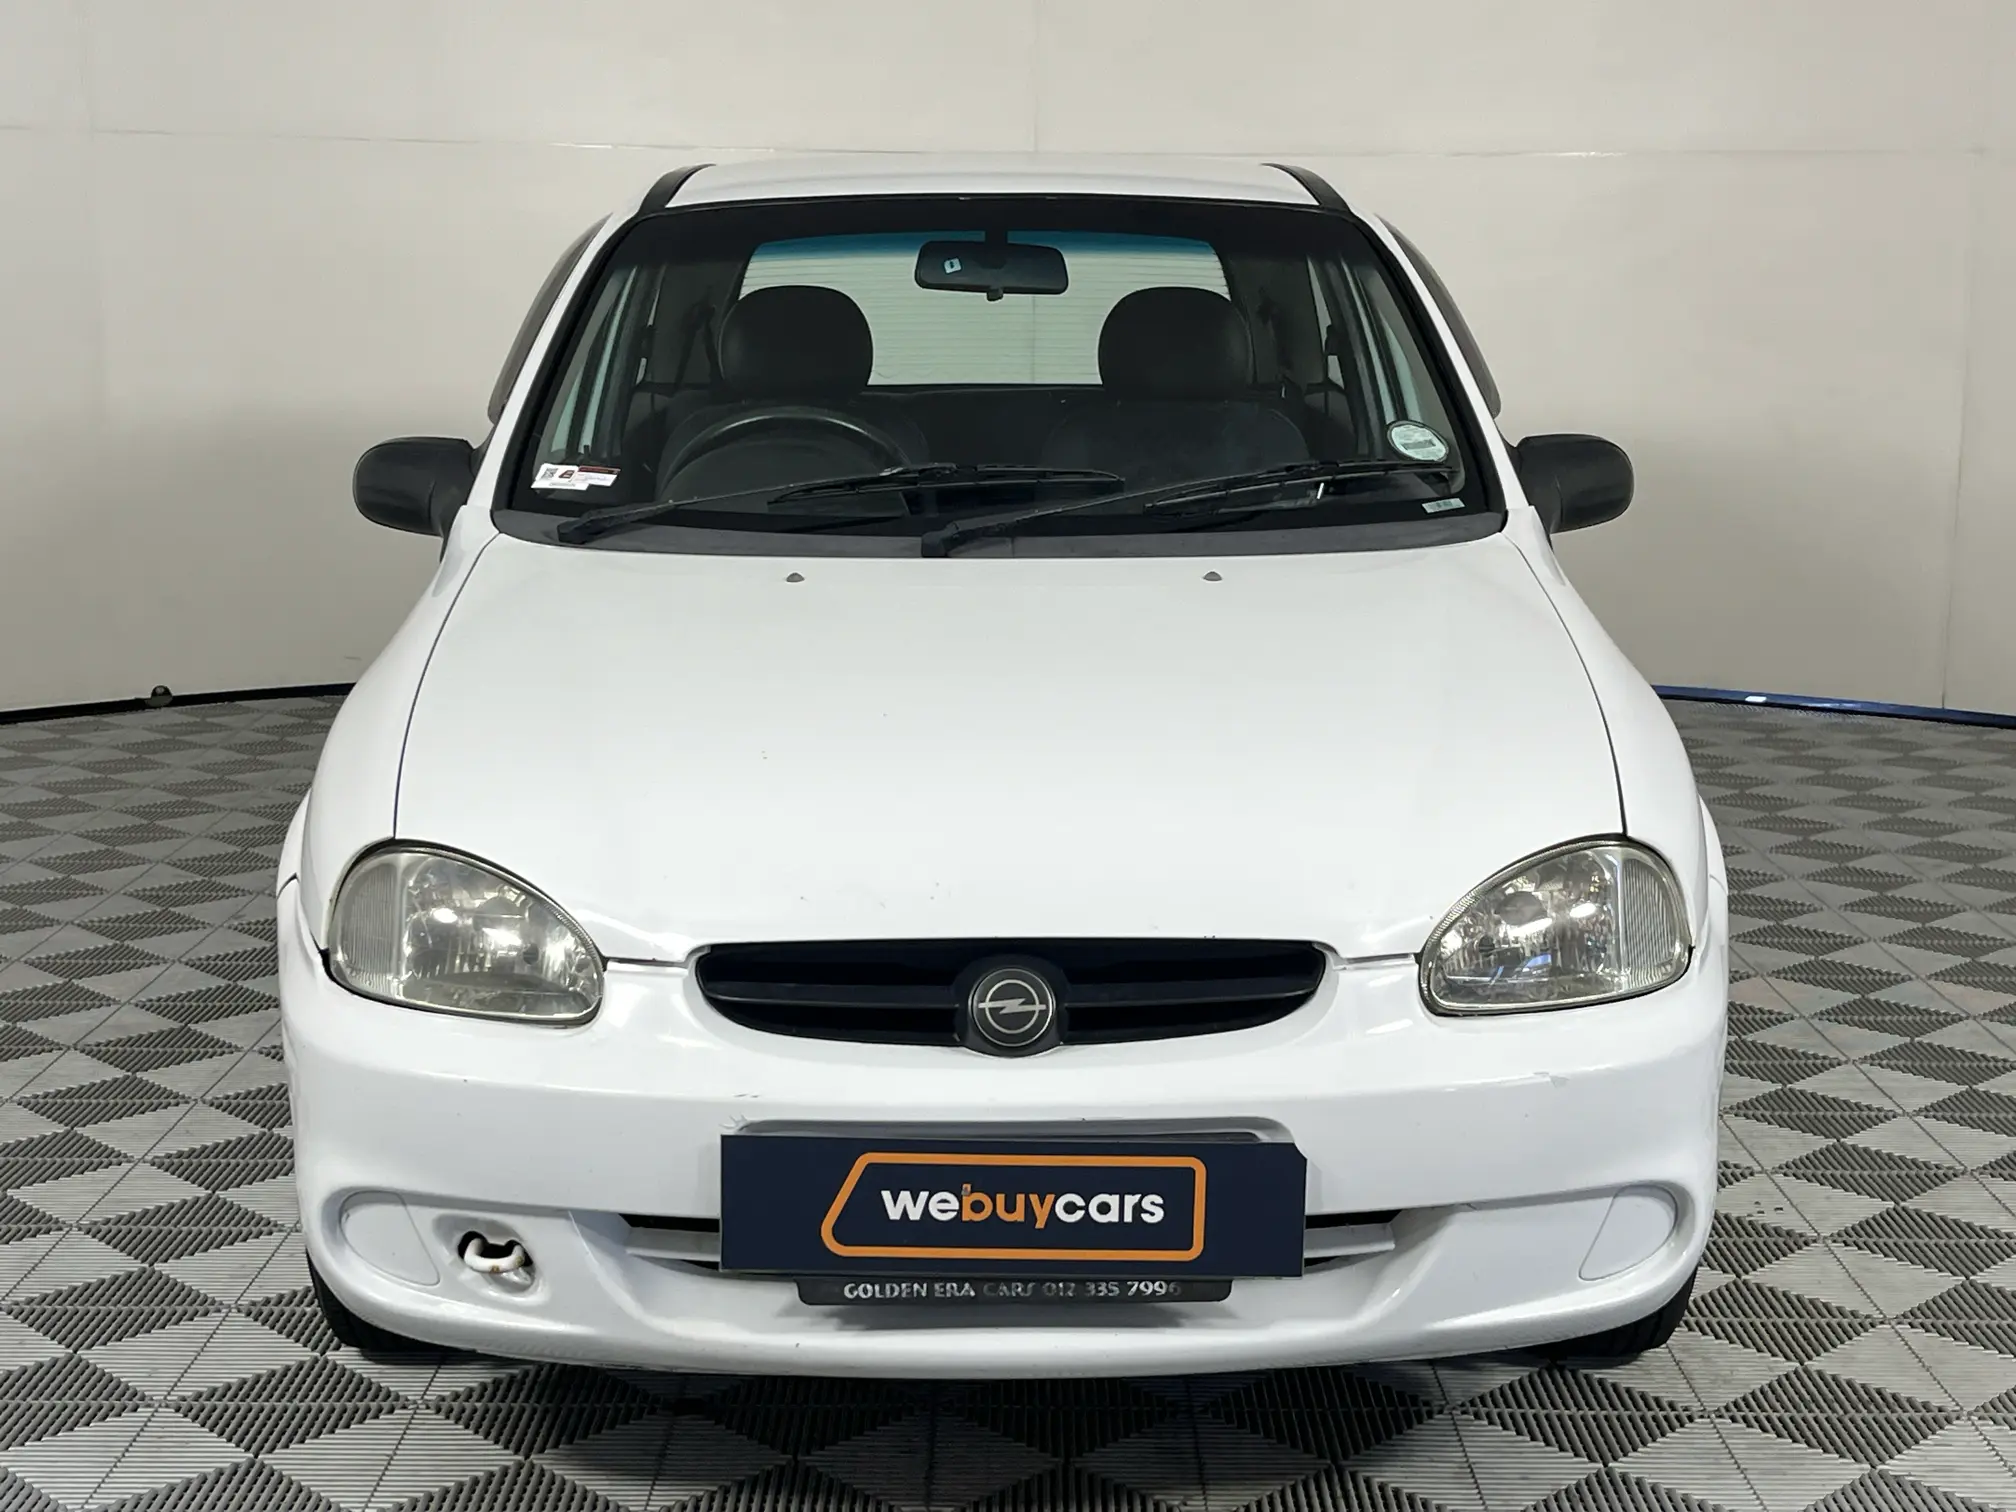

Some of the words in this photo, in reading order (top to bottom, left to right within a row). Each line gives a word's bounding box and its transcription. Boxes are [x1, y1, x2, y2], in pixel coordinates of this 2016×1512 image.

[881, 1183, 1165, 1229] webuycars
[843, 1282, 927, 1298] GOLDEN
[934, 1282, 976, 1297] ERA
[983, 1281, 1036, 1297] CARS
[1042, 1281, 1076, 1297] 012
[1084, 1281, 1120, 1297] 335
[1127, 1280, 1181, 1296] 7996
